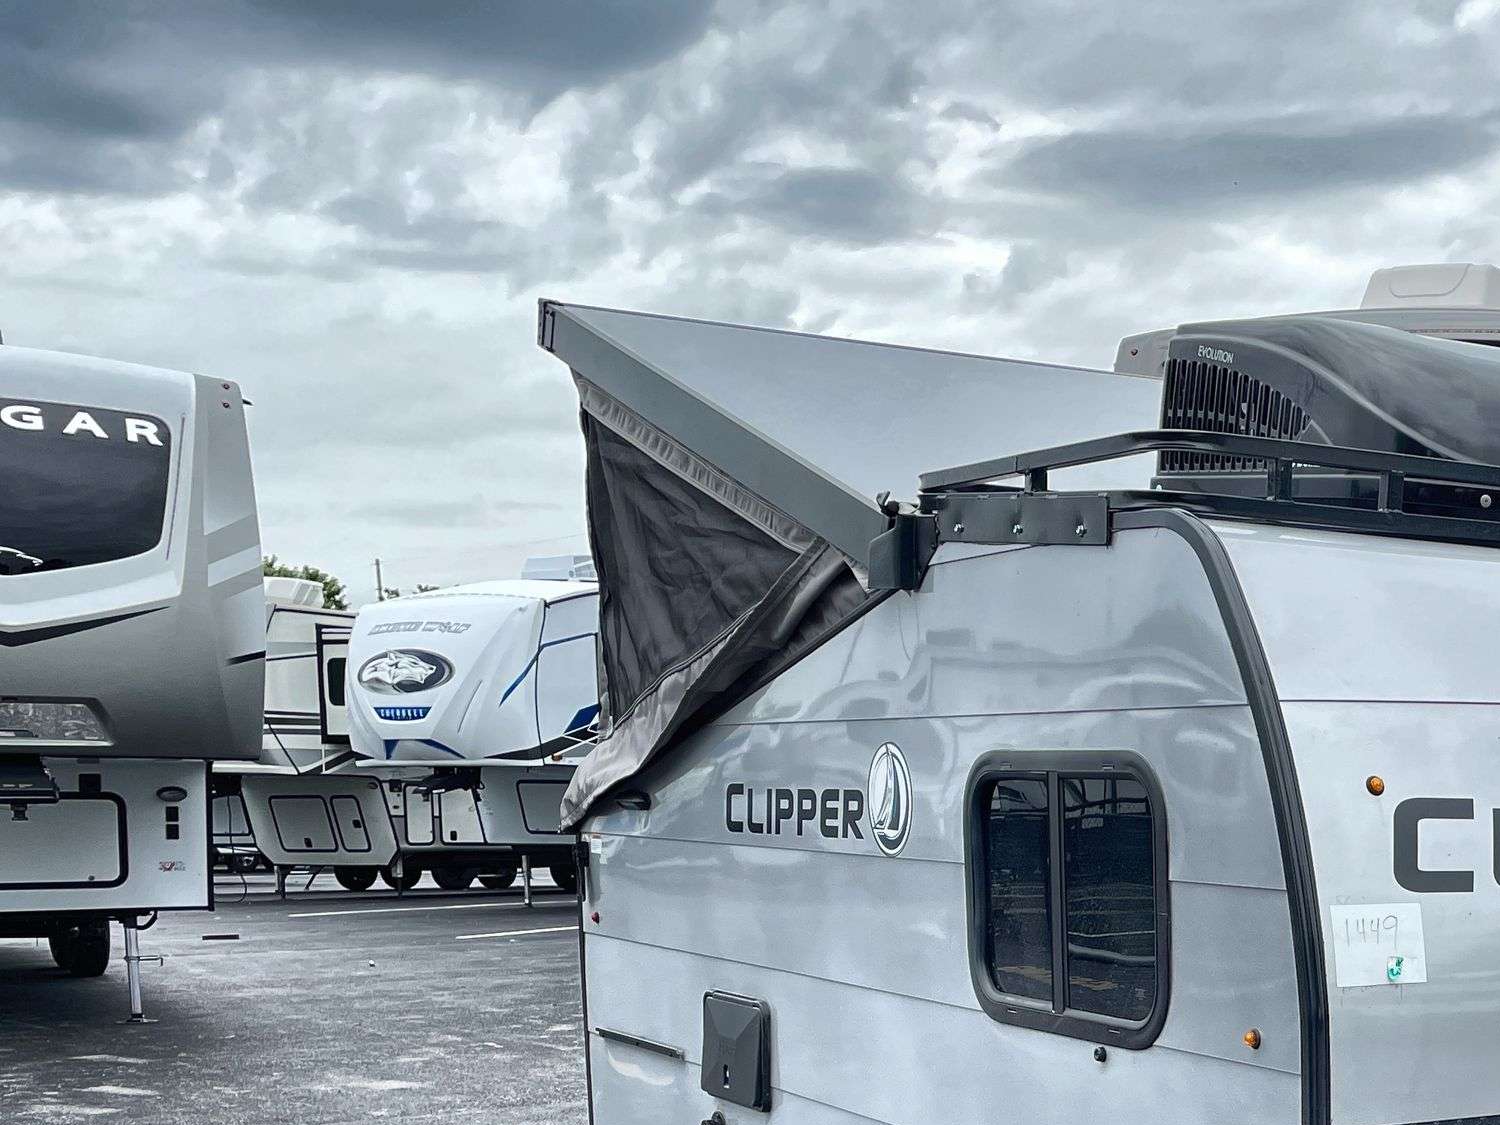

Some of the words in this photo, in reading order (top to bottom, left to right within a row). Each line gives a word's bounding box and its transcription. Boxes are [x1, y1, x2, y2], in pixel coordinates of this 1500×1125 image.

[1197, 345, 1234, 363] EVOLUTION
[0, 404, 163, 447] GAR
[726, 783, 865, 840] CLIPPER
[1345, 915, 1398, 950] 1449
